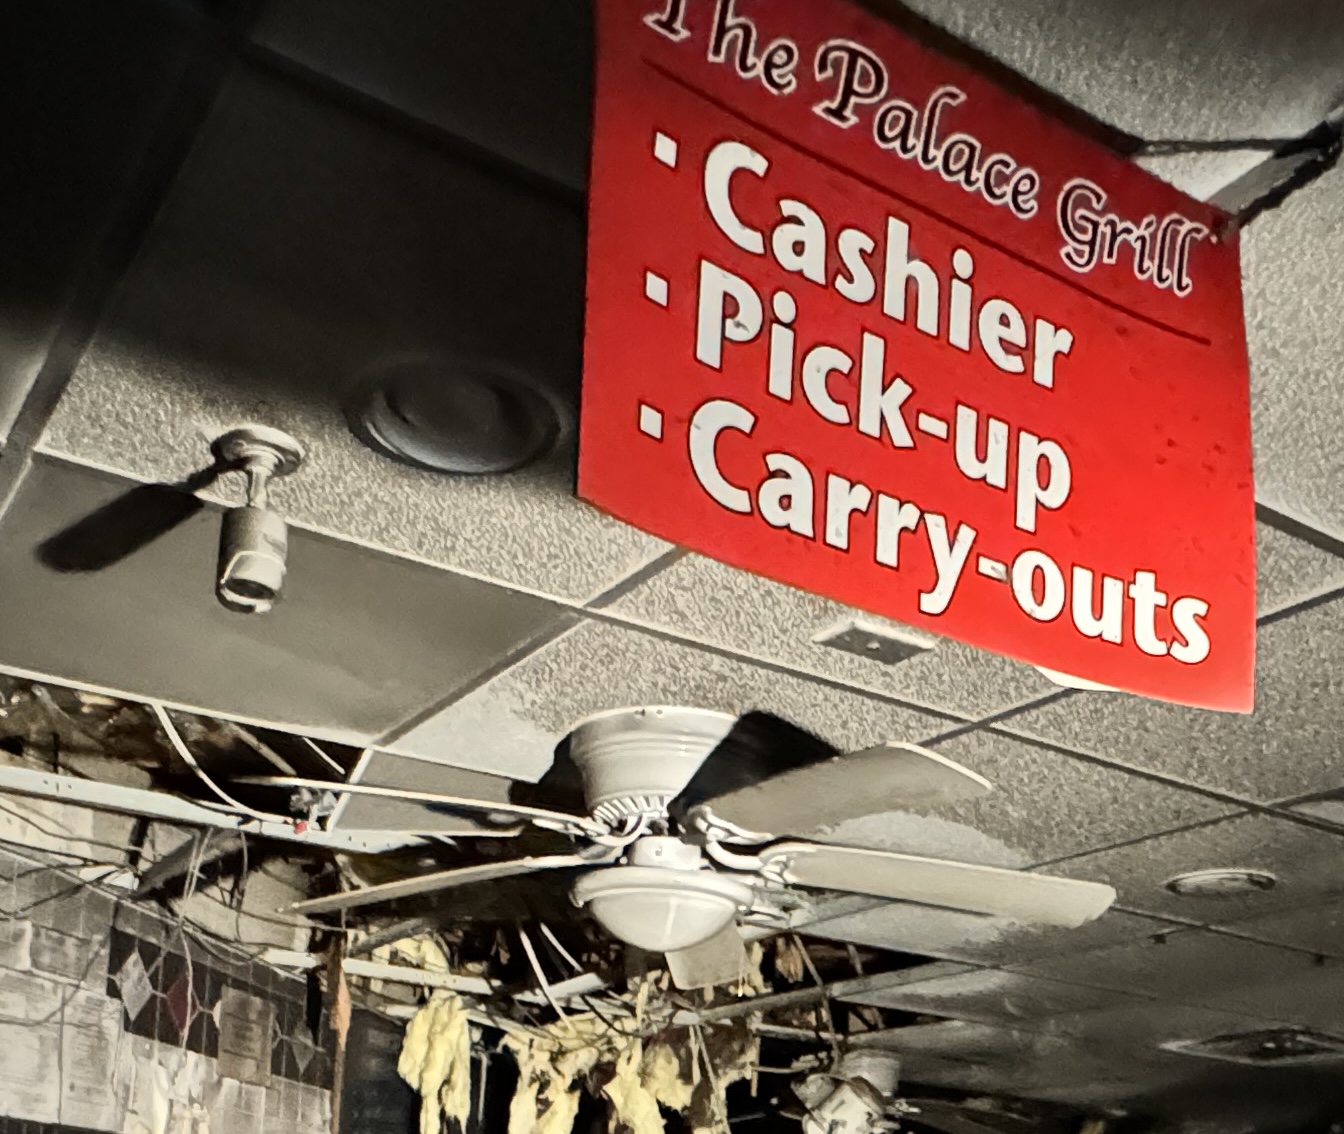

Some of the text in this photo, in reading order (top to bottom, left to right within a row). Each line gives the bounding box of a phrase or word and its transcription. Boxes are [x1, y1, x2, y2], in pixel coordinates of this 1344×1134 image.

[702, 139, 1074, 390] Cashier
[814, 38, 1041, 220] Palace
[1057, 178, 1210, 297] Grill
[693, 258, 1073, 533] Pick-up
[687, 400, 1212, 664] Carry-outs
